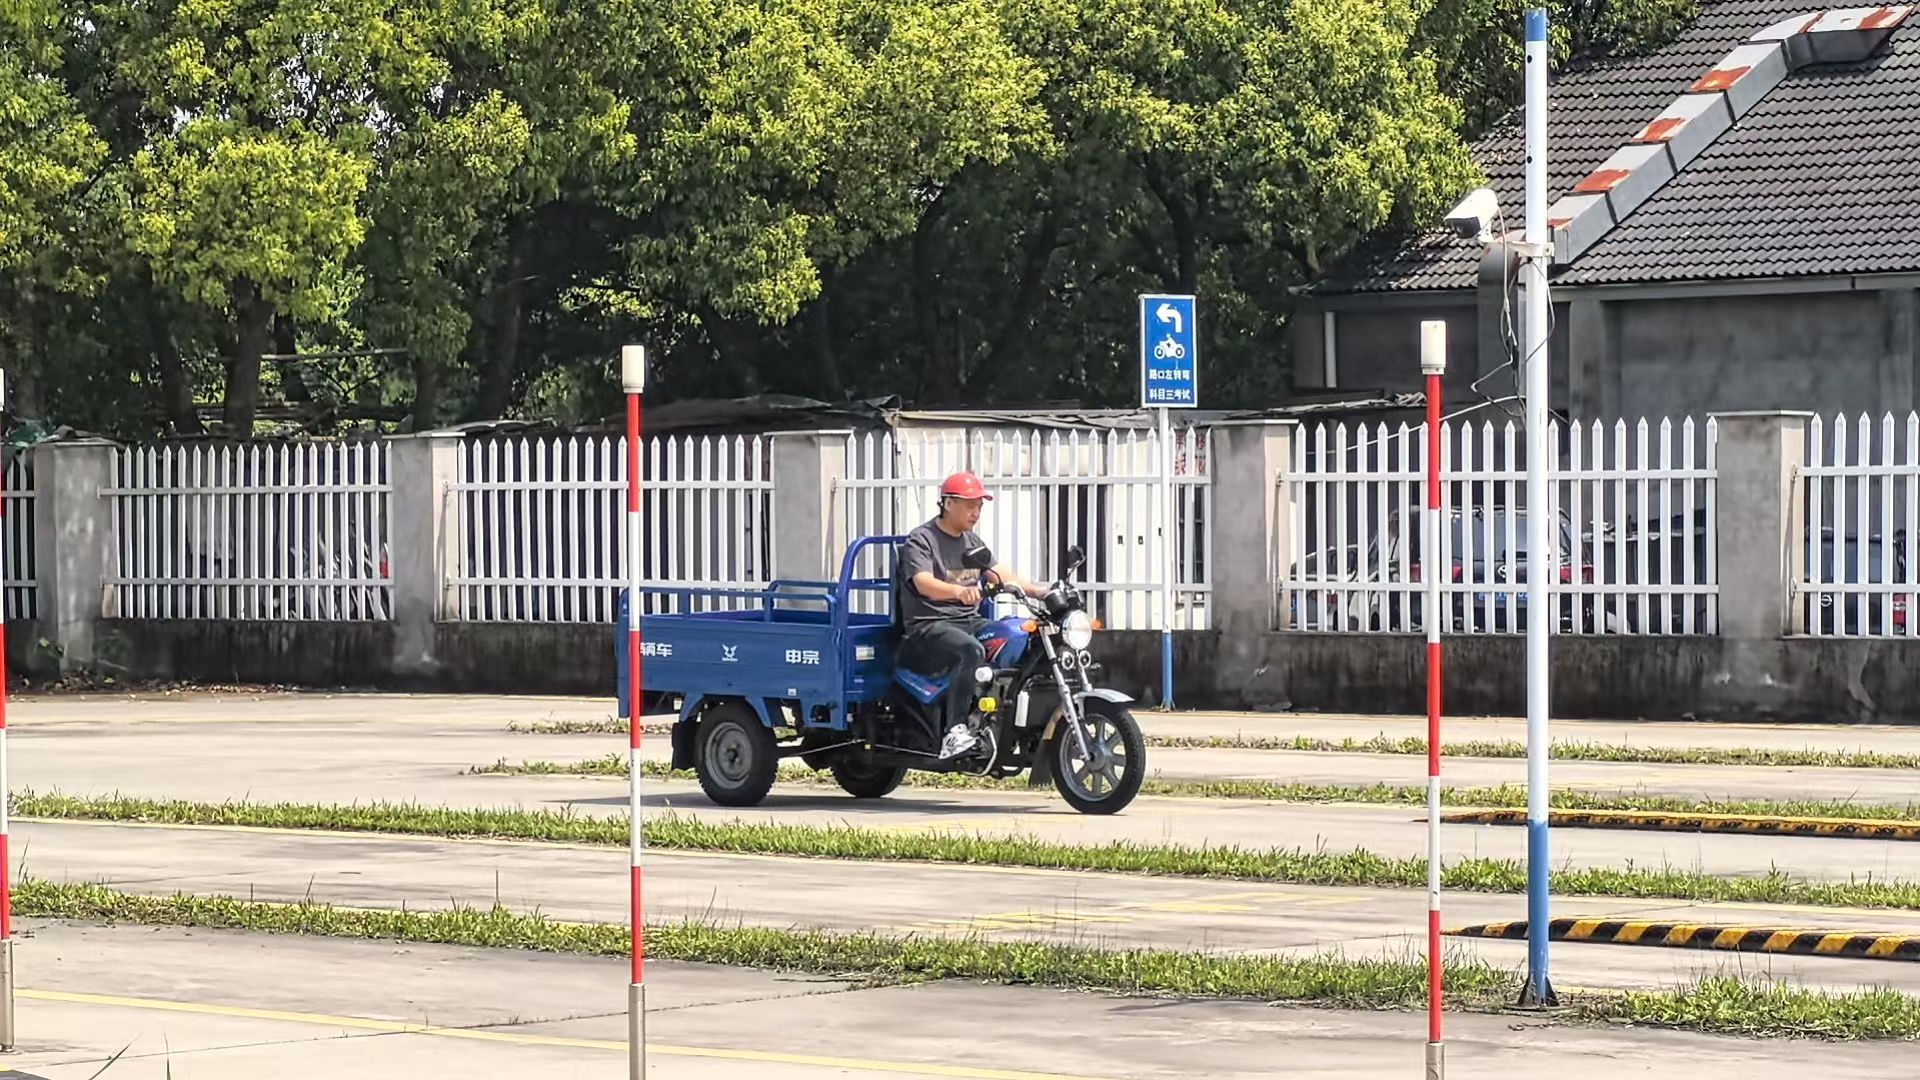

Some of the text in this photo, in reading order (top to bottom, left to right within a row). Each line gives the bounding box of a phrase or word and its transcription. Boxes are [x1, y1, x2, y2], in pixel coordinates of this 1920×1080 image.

[1149, 388, 1191, 400] 科目三考试
